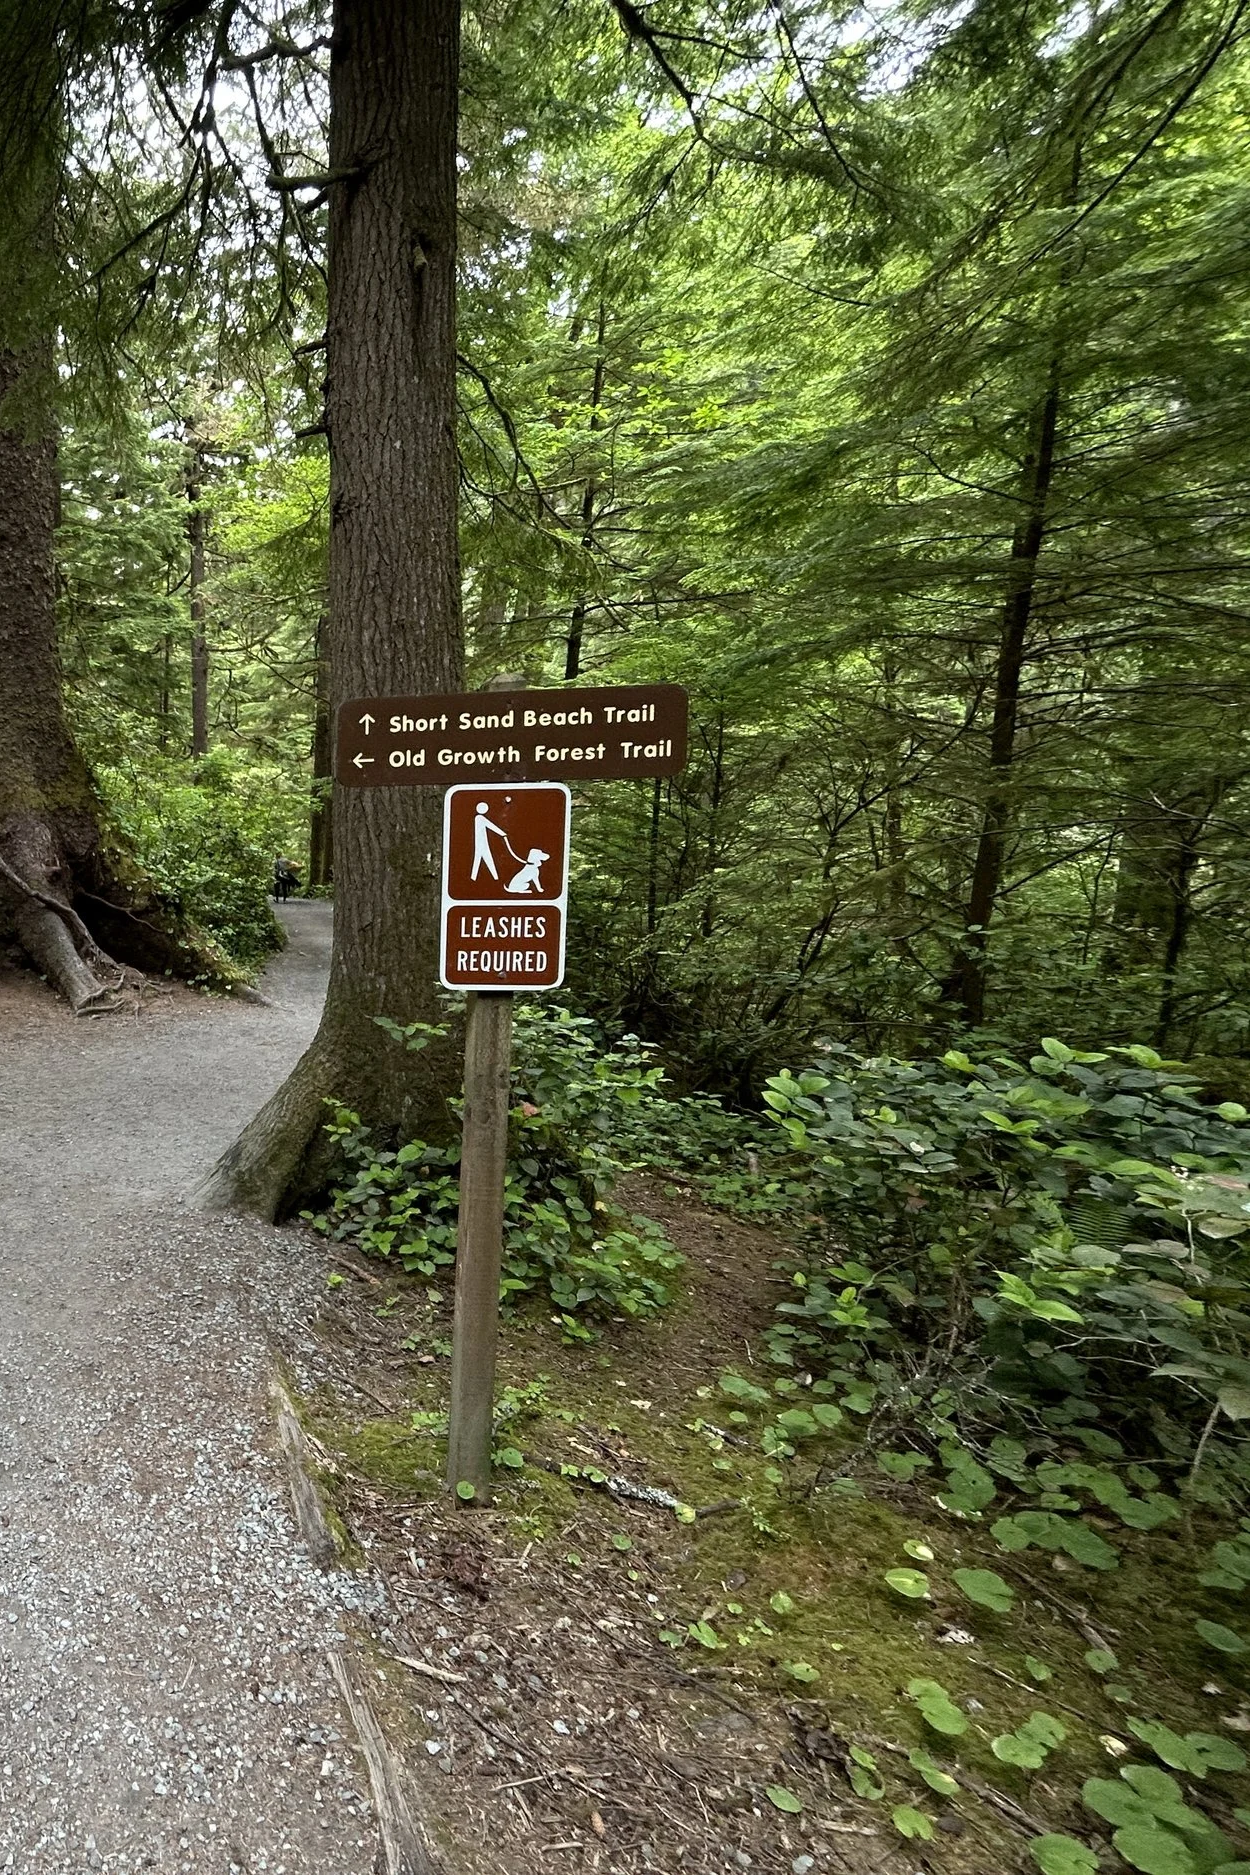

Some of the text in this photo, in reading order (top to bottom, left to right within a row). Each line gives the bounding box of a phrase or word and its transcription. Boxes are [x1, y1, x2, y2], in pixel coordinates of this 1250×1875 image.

[389, 704, 655, 734] Short Sand Beach Trail
[389, 740, 672, 768] Old Growth Forest Trail
[460, 916, 546, 938] LEASHES
[457, 950, 548, 972] REQUIRED
